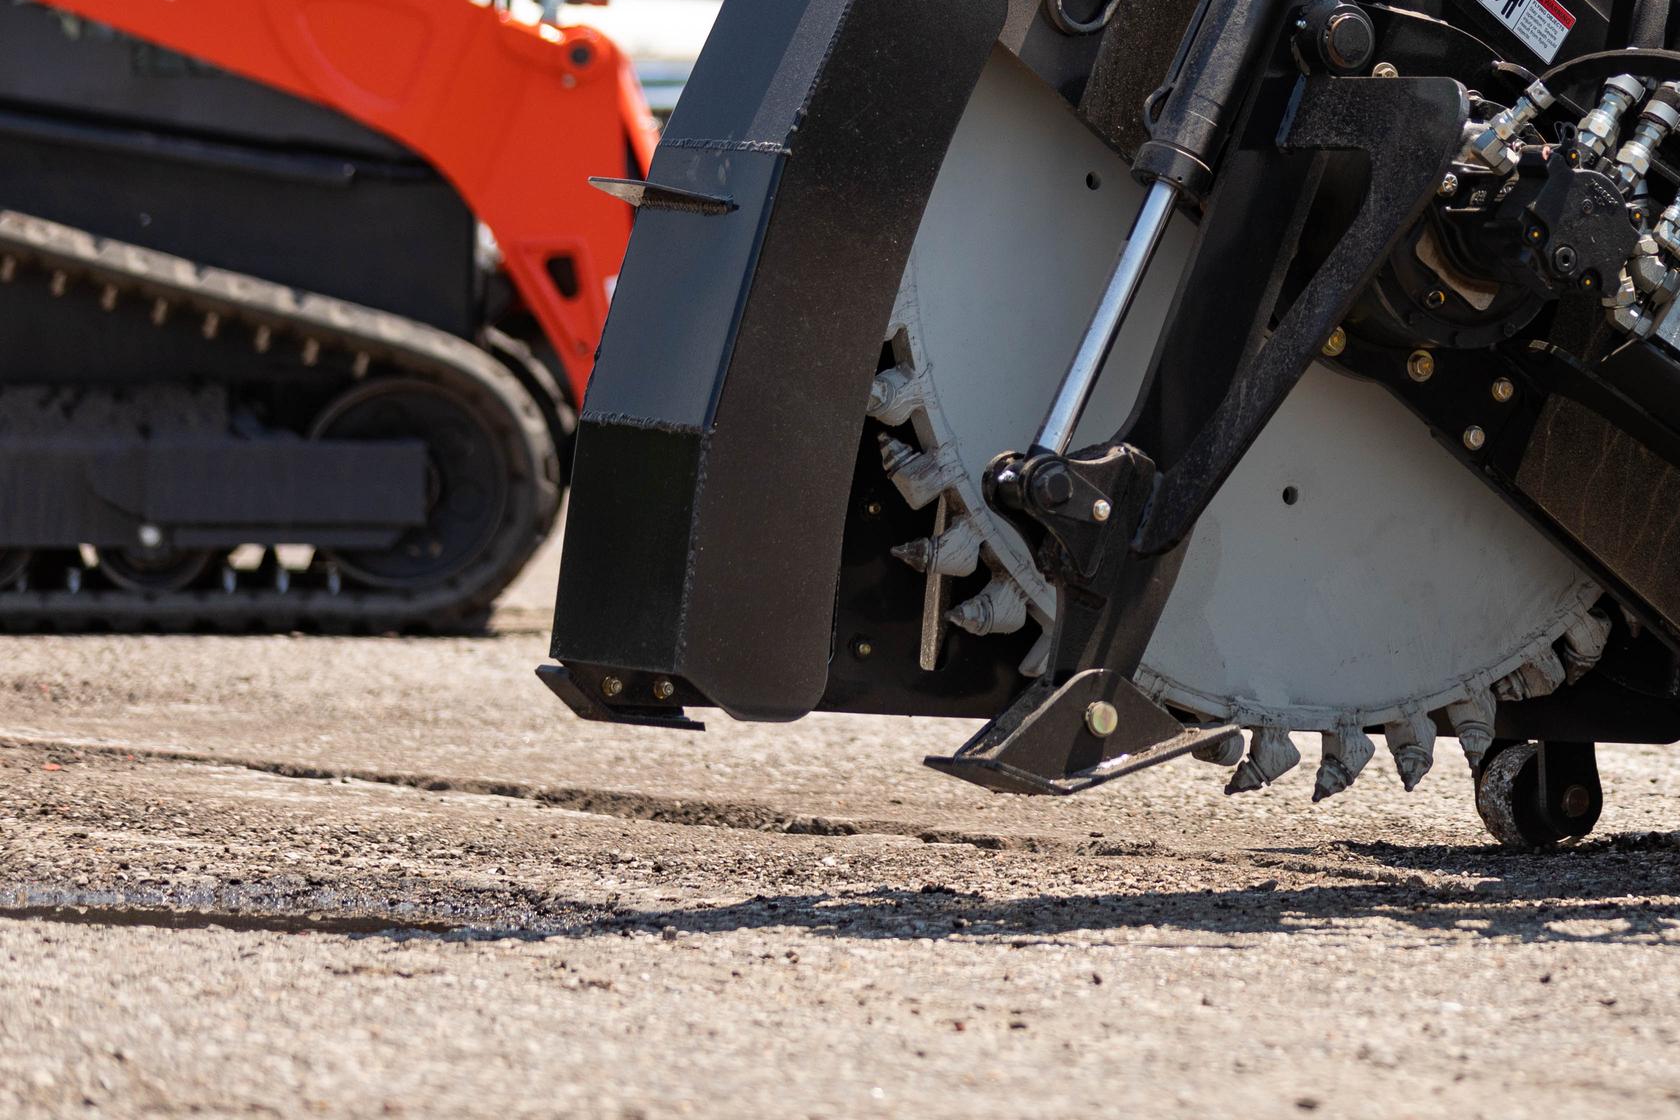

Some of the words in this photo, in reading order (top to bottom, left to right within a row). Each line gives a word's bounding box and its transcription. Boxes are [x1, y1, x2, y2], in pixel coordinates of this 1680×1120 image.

[1527, 5, 1538, 17] Stay
[1536, 14, 1547, 25] away
[1544, 21, 1558, 35] during
[1531, 0, 1547, 15] FLYING
[1544, 12, 1565, 32] OBJECTS
[1518, 20, 1530, 32] result
[1529, 29, 1539, 40] from
[1536, 36, 1549, 49] flying
[1535, 28, 1548, 40] death
[1545, 37, 1557, 49] could
[1542, 26, 1557, 41] Severe
